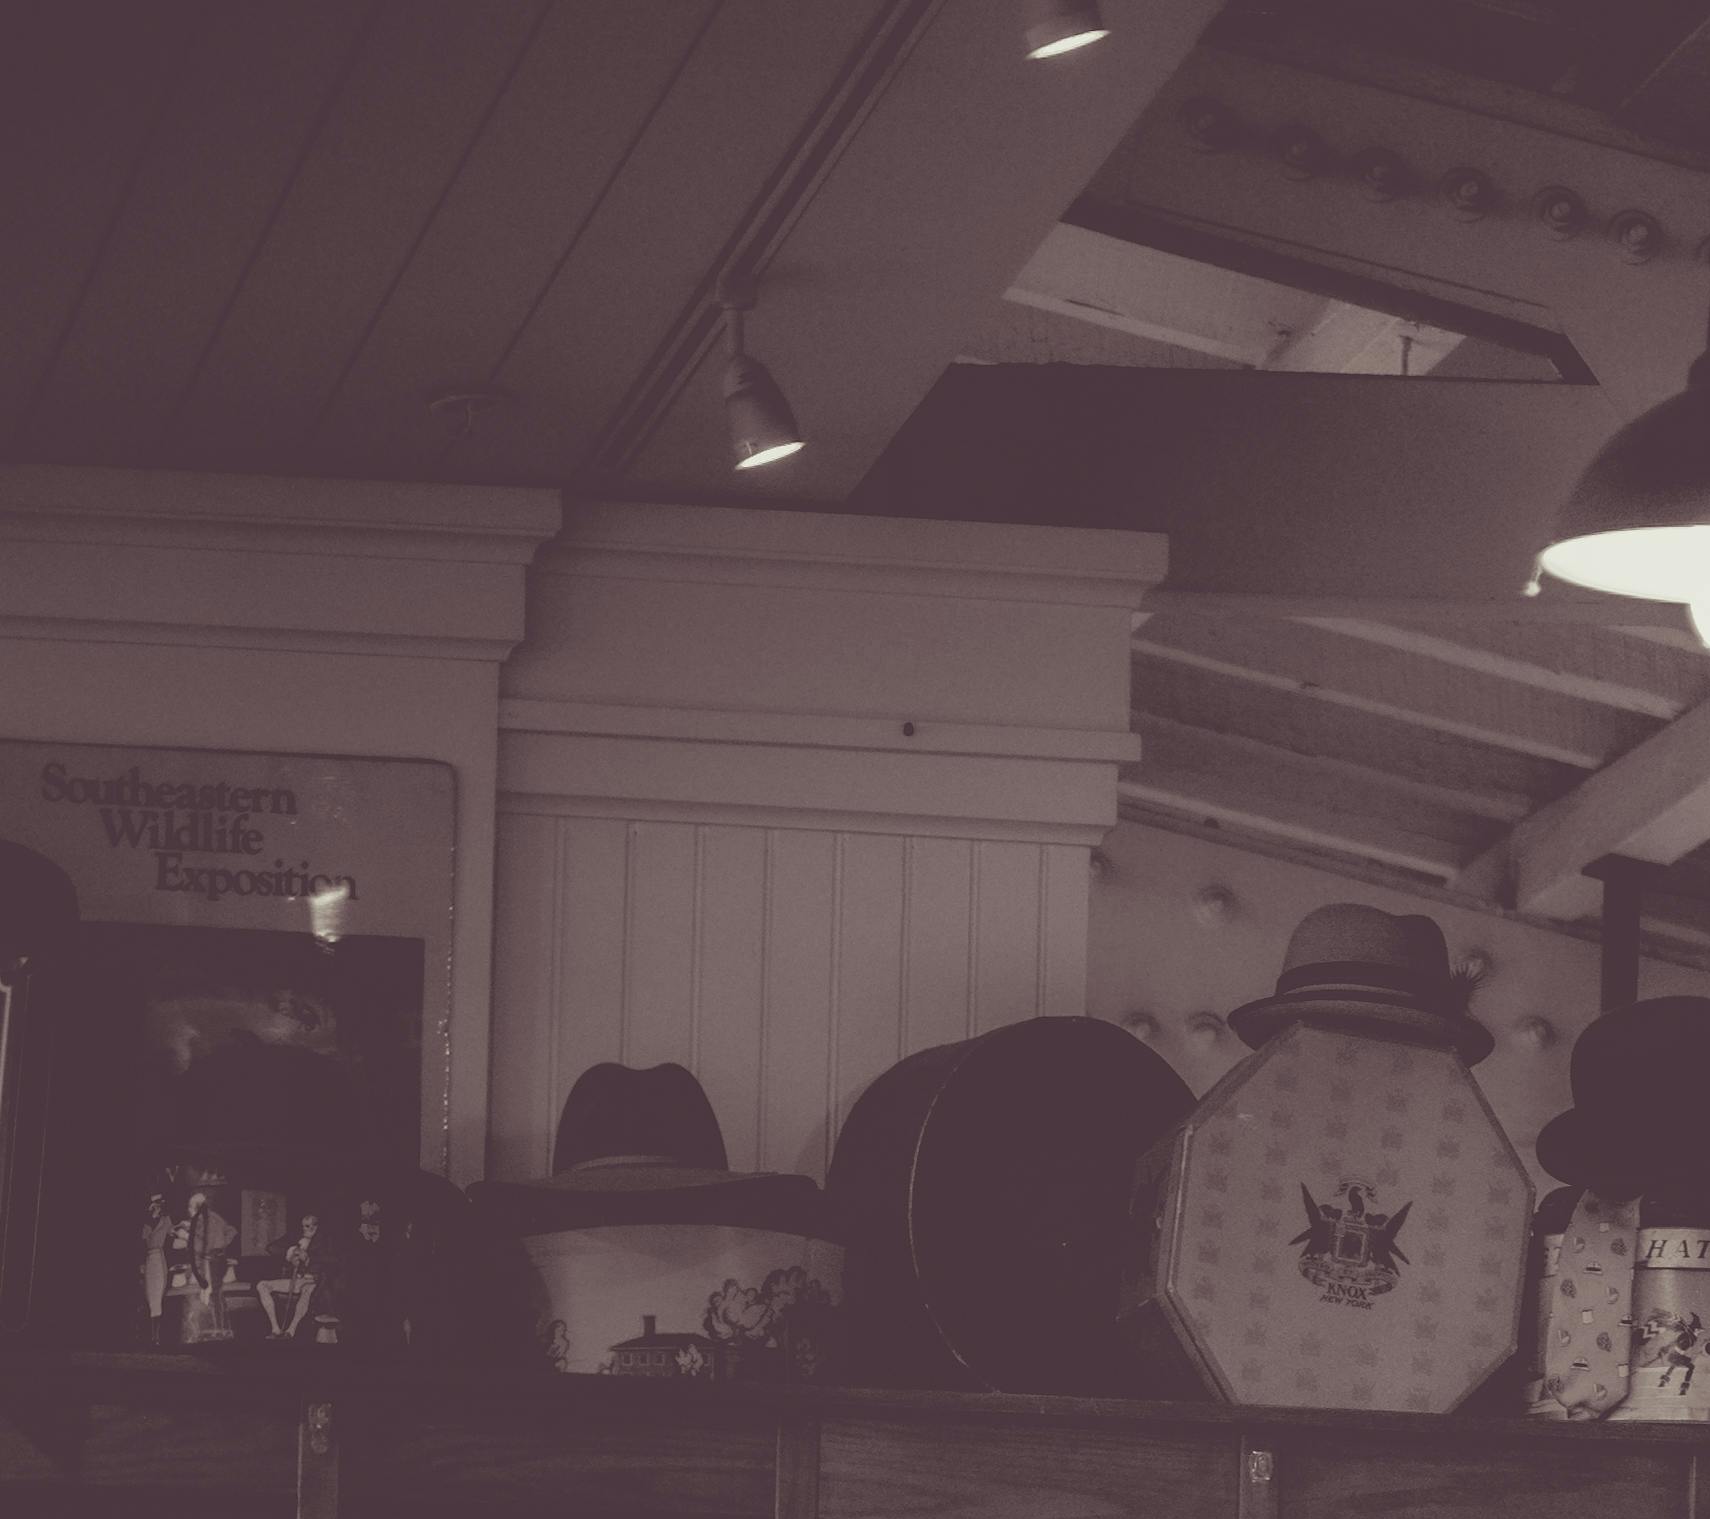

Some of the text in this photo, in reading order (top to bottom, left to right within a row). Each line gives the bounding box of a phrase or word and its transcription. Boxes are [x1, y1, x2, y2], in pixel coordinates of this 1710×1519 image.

[41, 761, 299, 815] Southeastern
[99, 808, 264, 855] Wildlife
[154, 851, 358, 901] Exposition
[1320, 1294, 1374, 1310] NEW YORK
[1327, 1282, 1367, 1300] KNOX
